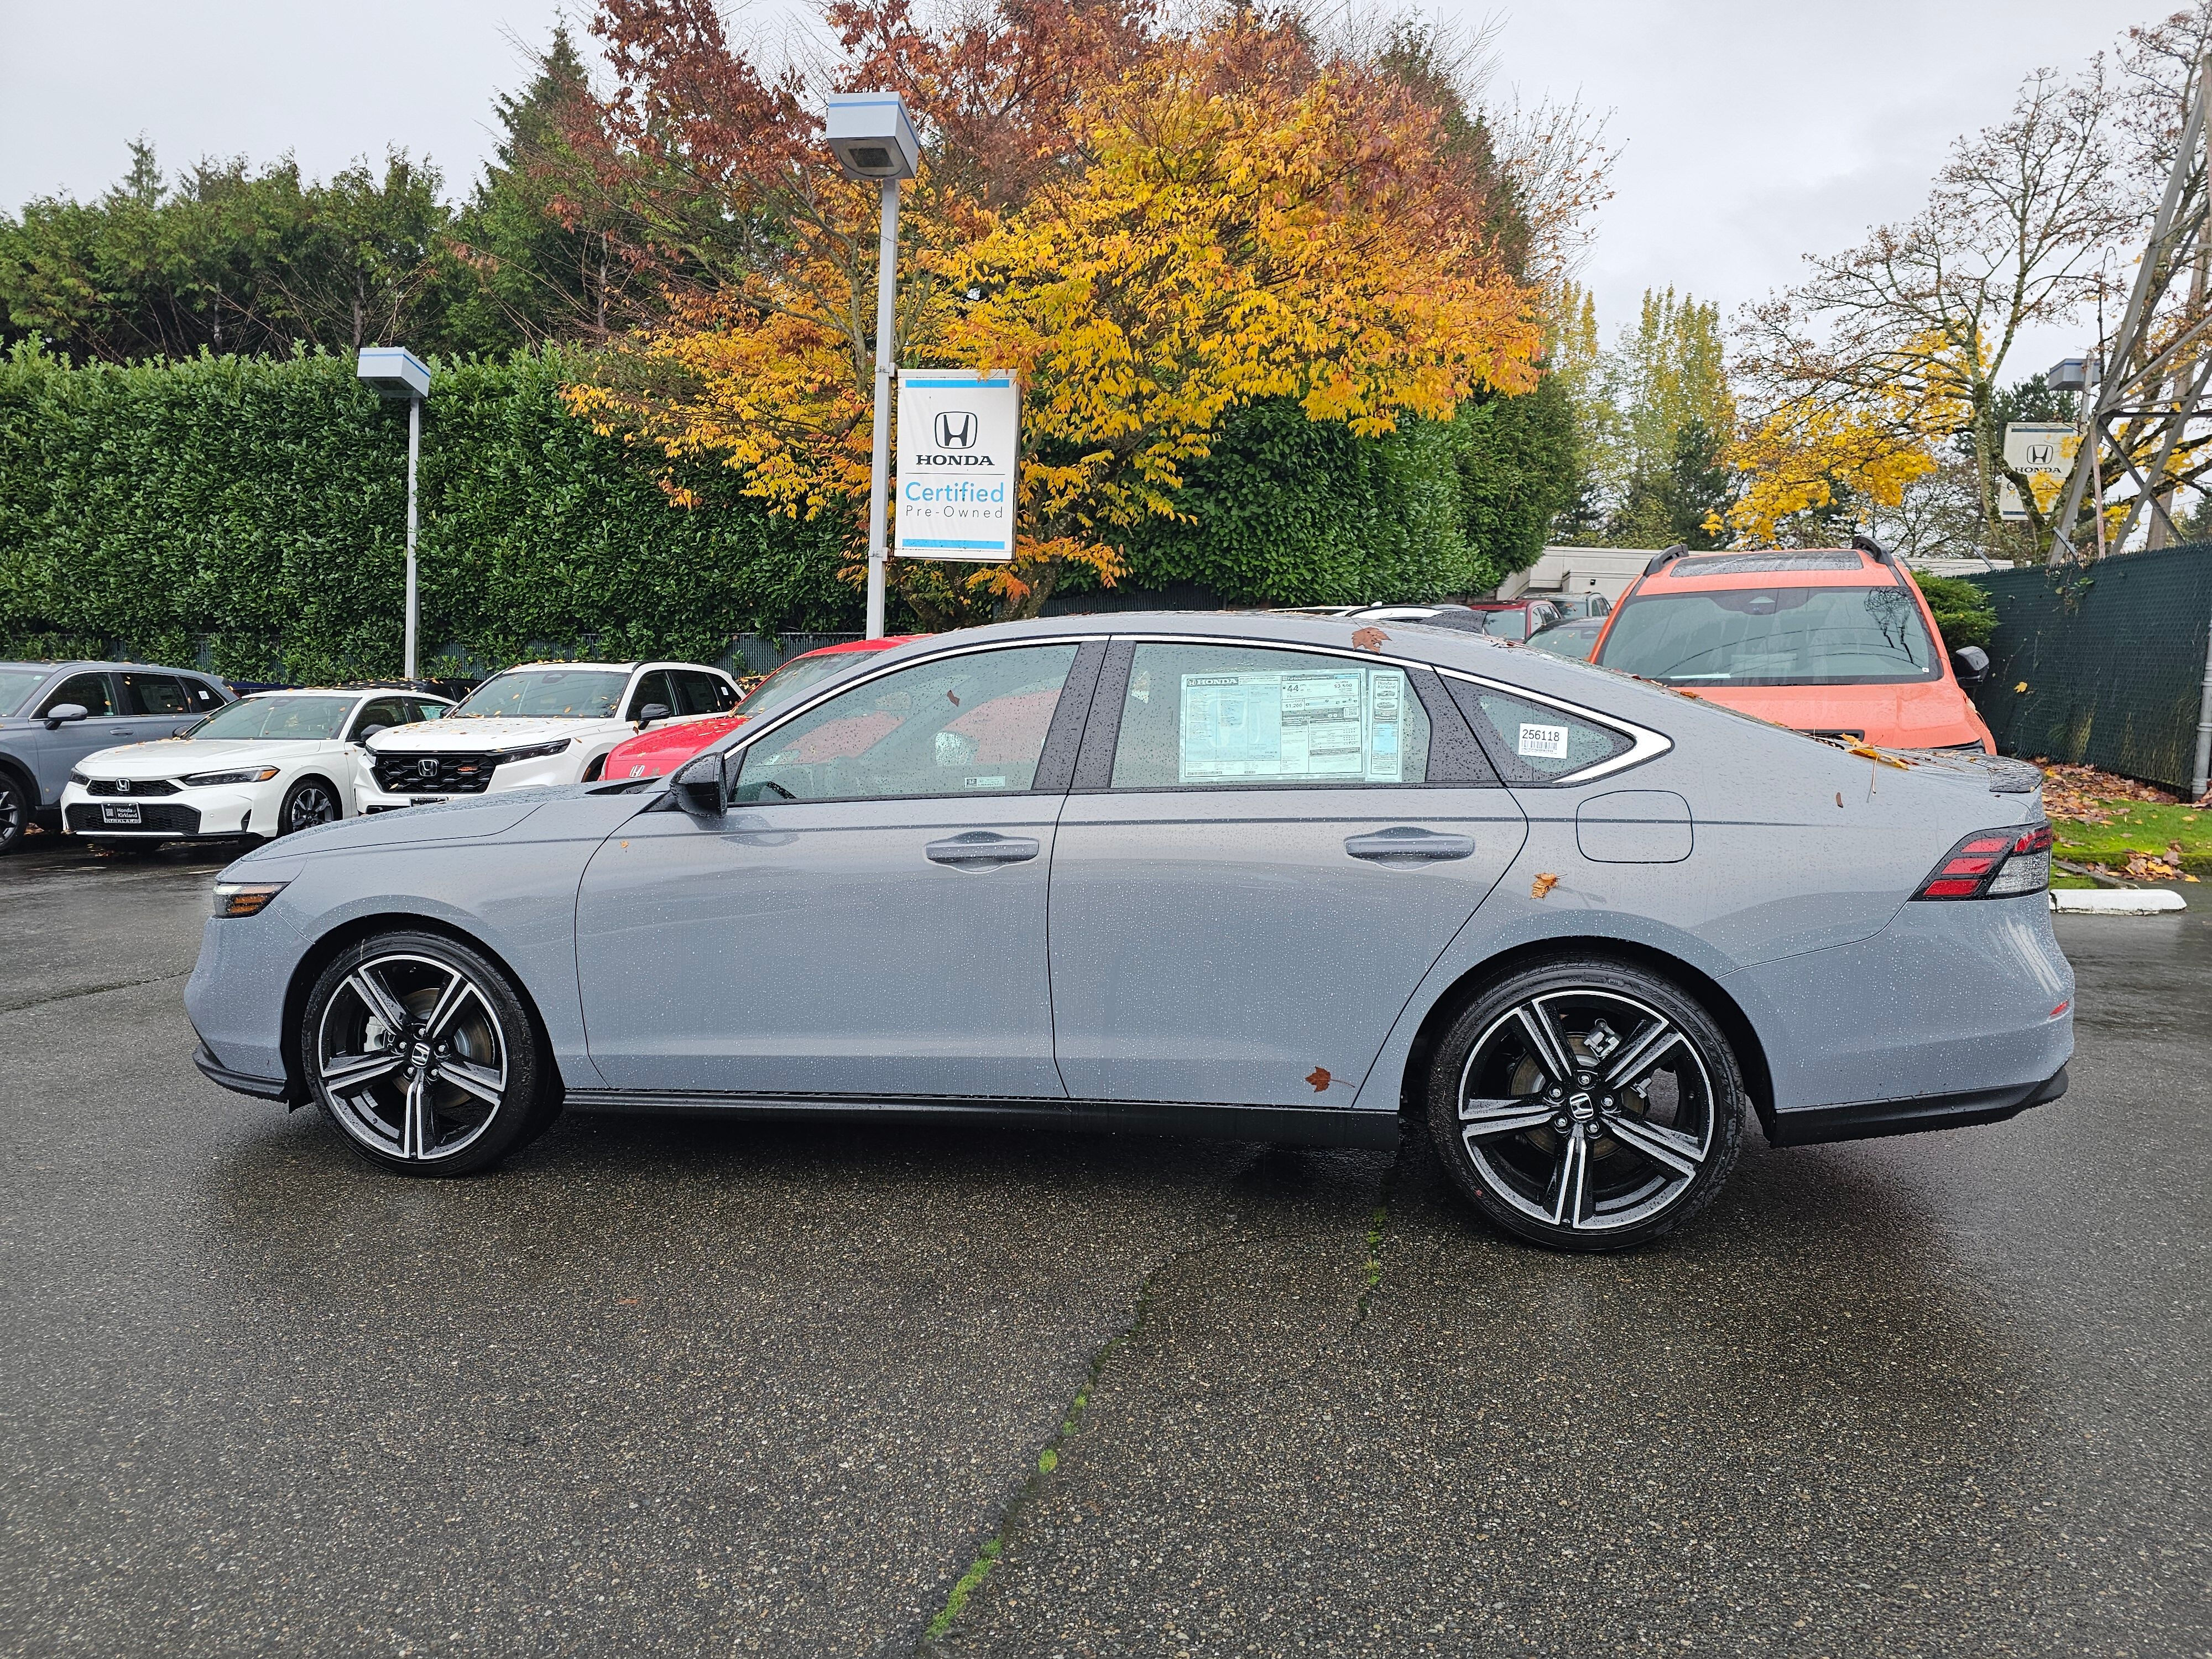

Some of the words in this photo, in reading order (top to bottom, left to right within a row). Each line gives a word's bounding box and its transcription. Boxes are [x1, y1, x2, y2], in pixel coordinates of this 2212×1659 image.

[916, 455, 995, 466] HONDA
[905, 481, 1004, 503] Certified
[906, 505, 1003, 518] Pre-Owned
[1522, 729, 1559, 742] 256118
